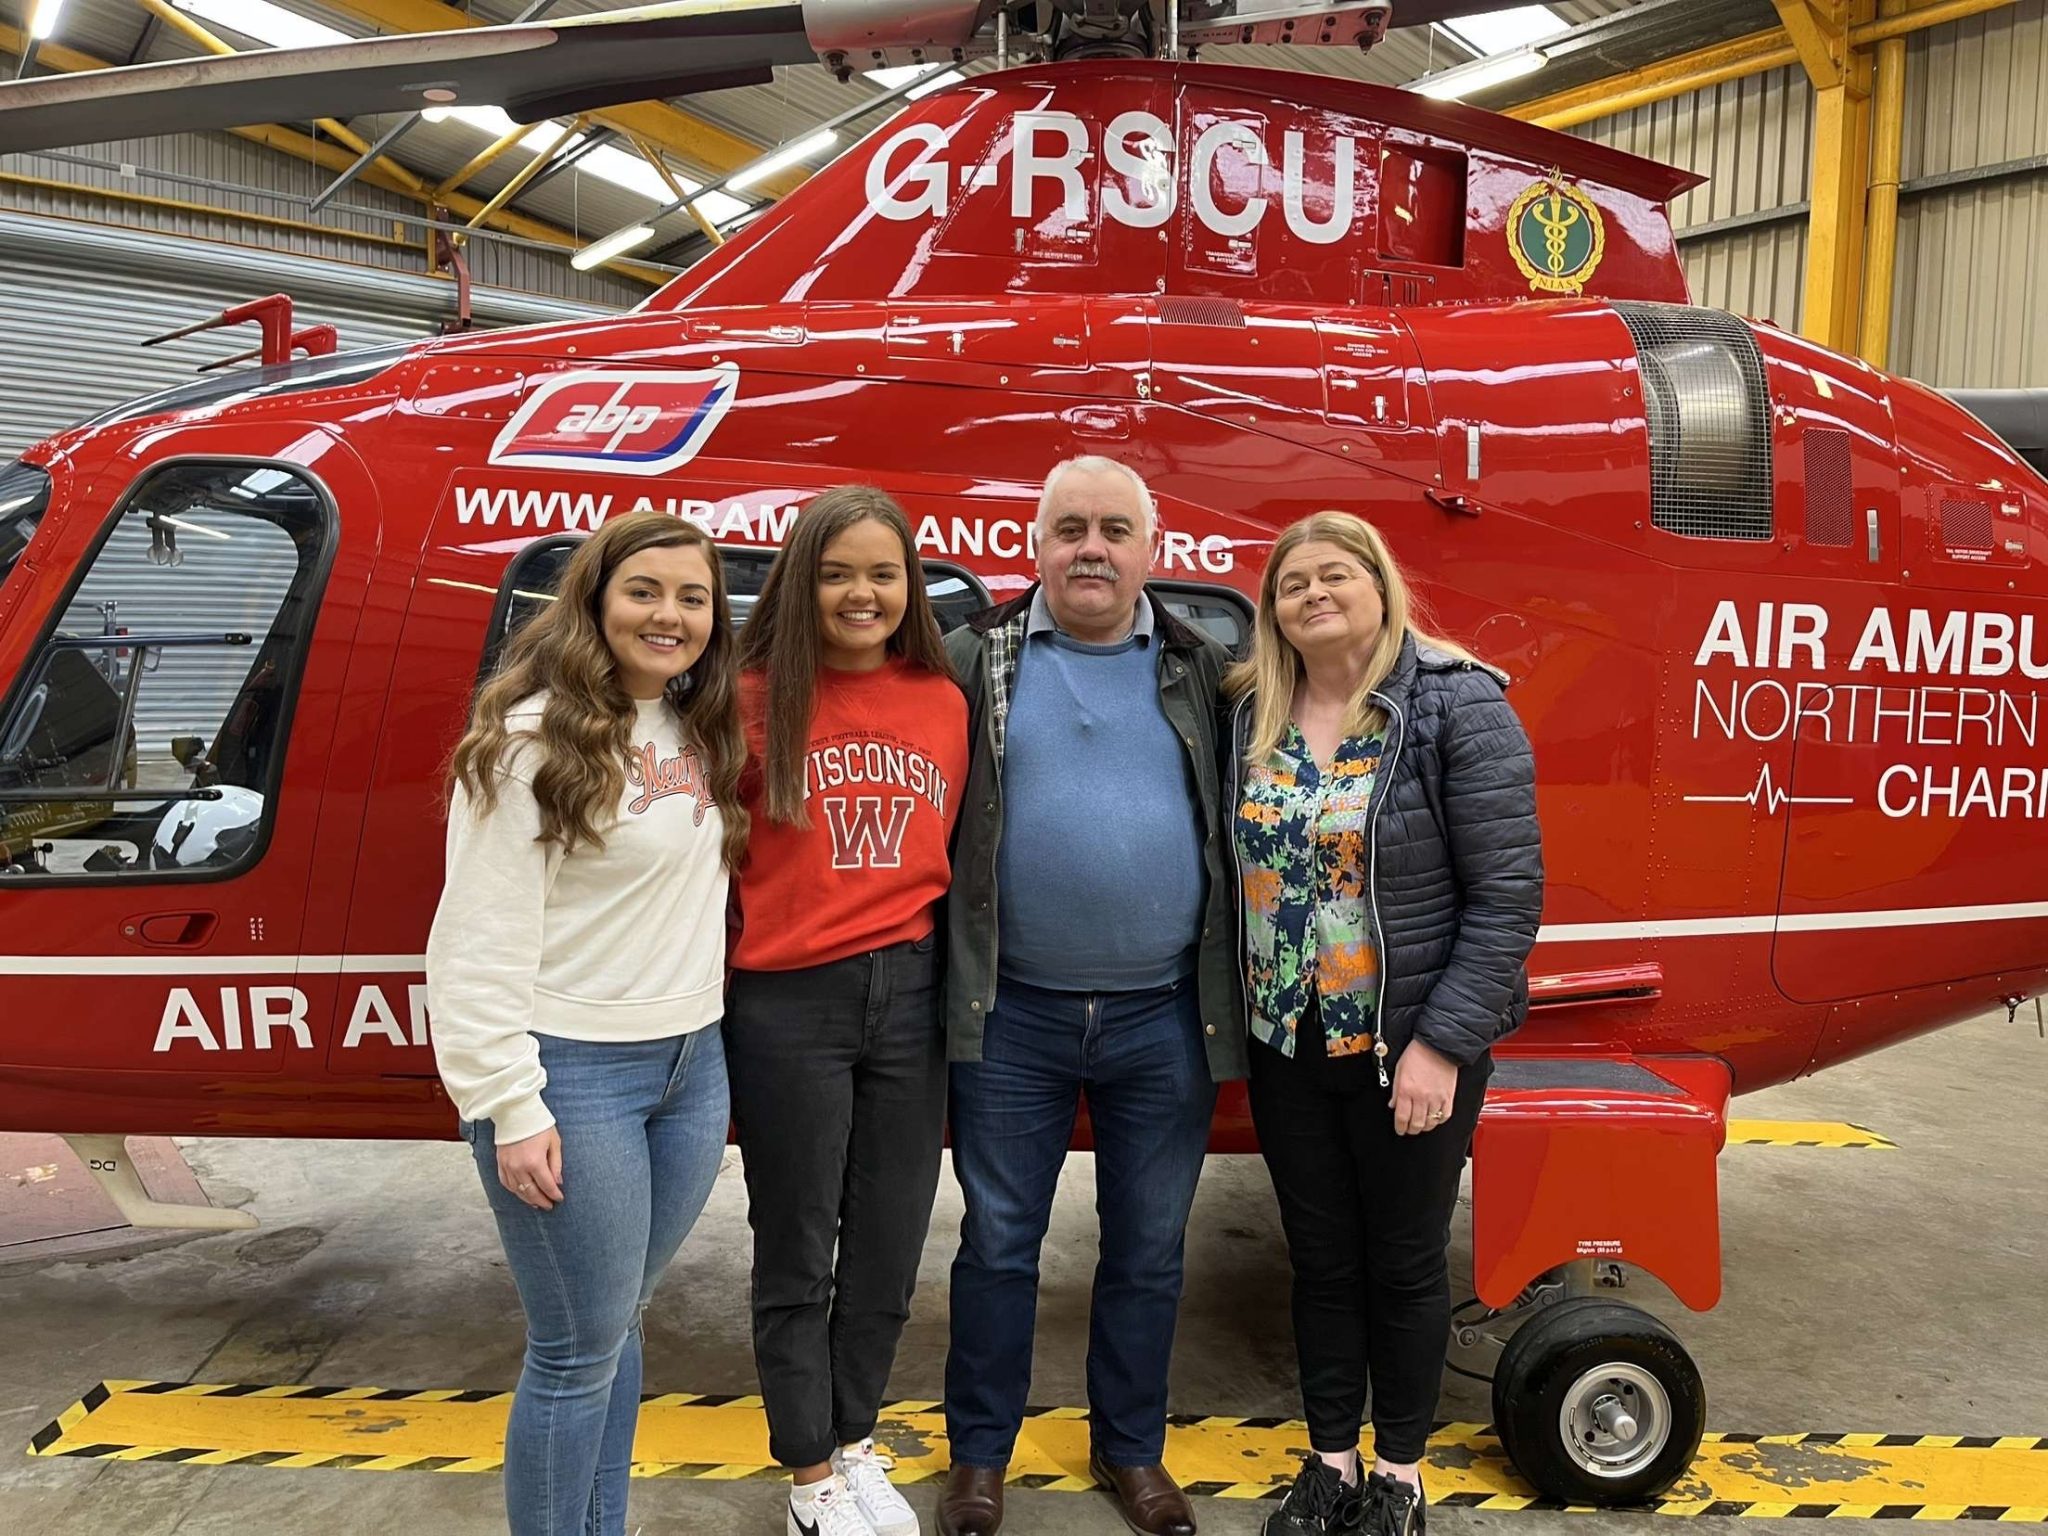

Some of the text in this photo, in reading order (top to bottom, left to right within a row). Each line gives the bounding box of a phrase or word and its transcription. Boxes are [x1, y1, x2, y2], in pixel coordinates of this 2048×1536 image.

[865, 111, 1356, 244] G-RSCU
[555, 381, 662, 453] abp
[1693, 600, 2048, 680] AIR AMBU
[1693, 679, 2038, 747] NORTHERN
[823, 796, 914, 869] W
[153, 986, 314, 1052] AIR
